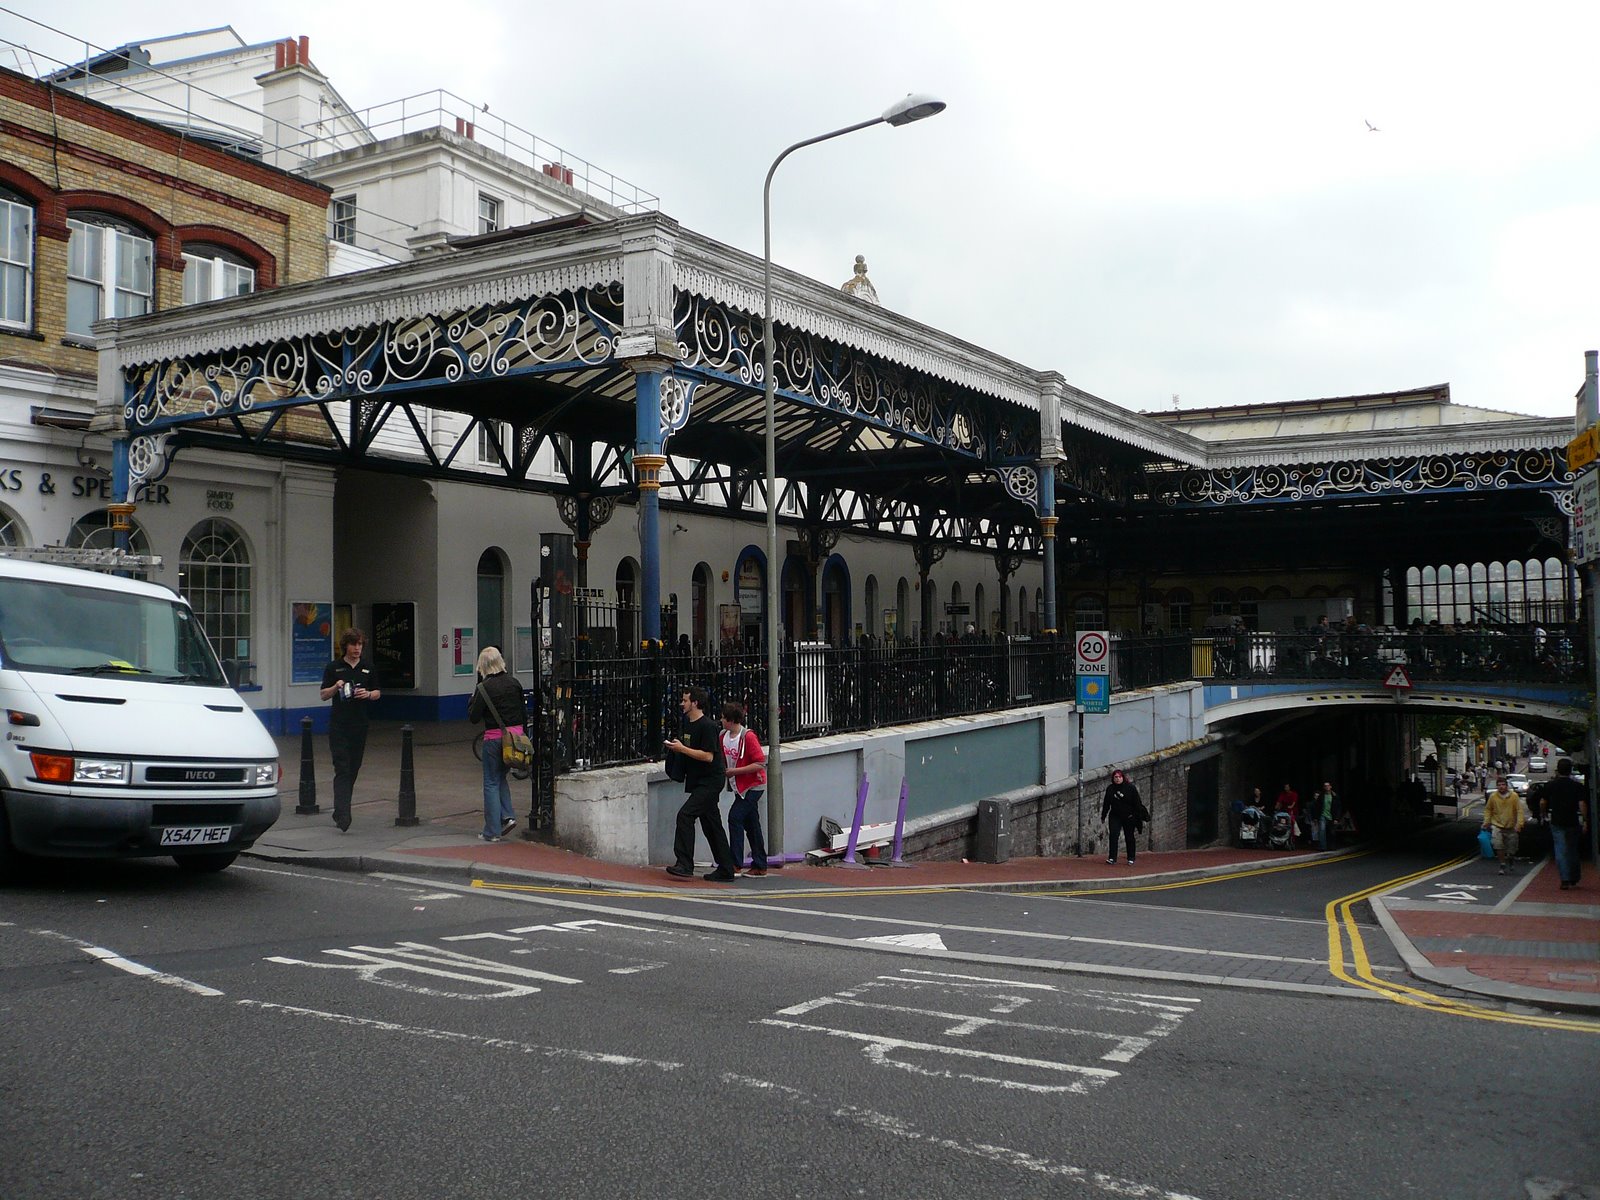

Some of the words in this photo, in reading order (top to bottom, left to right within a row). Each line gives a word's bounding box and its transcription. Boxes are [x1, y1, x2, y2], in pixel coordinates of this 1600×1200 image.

[39, 472, 55, 493] &
[72, 476, 170, 504] SPEER
[207, 500, 234, 510] FOOD
[1083, 642, 1102, 653] 20
[1079, 664, 1106, 672] ZONE
[185, 770, 215, 780] IVECO
[163, 829, 201, 842] X547
[203, 827, 229, 841] HEF
